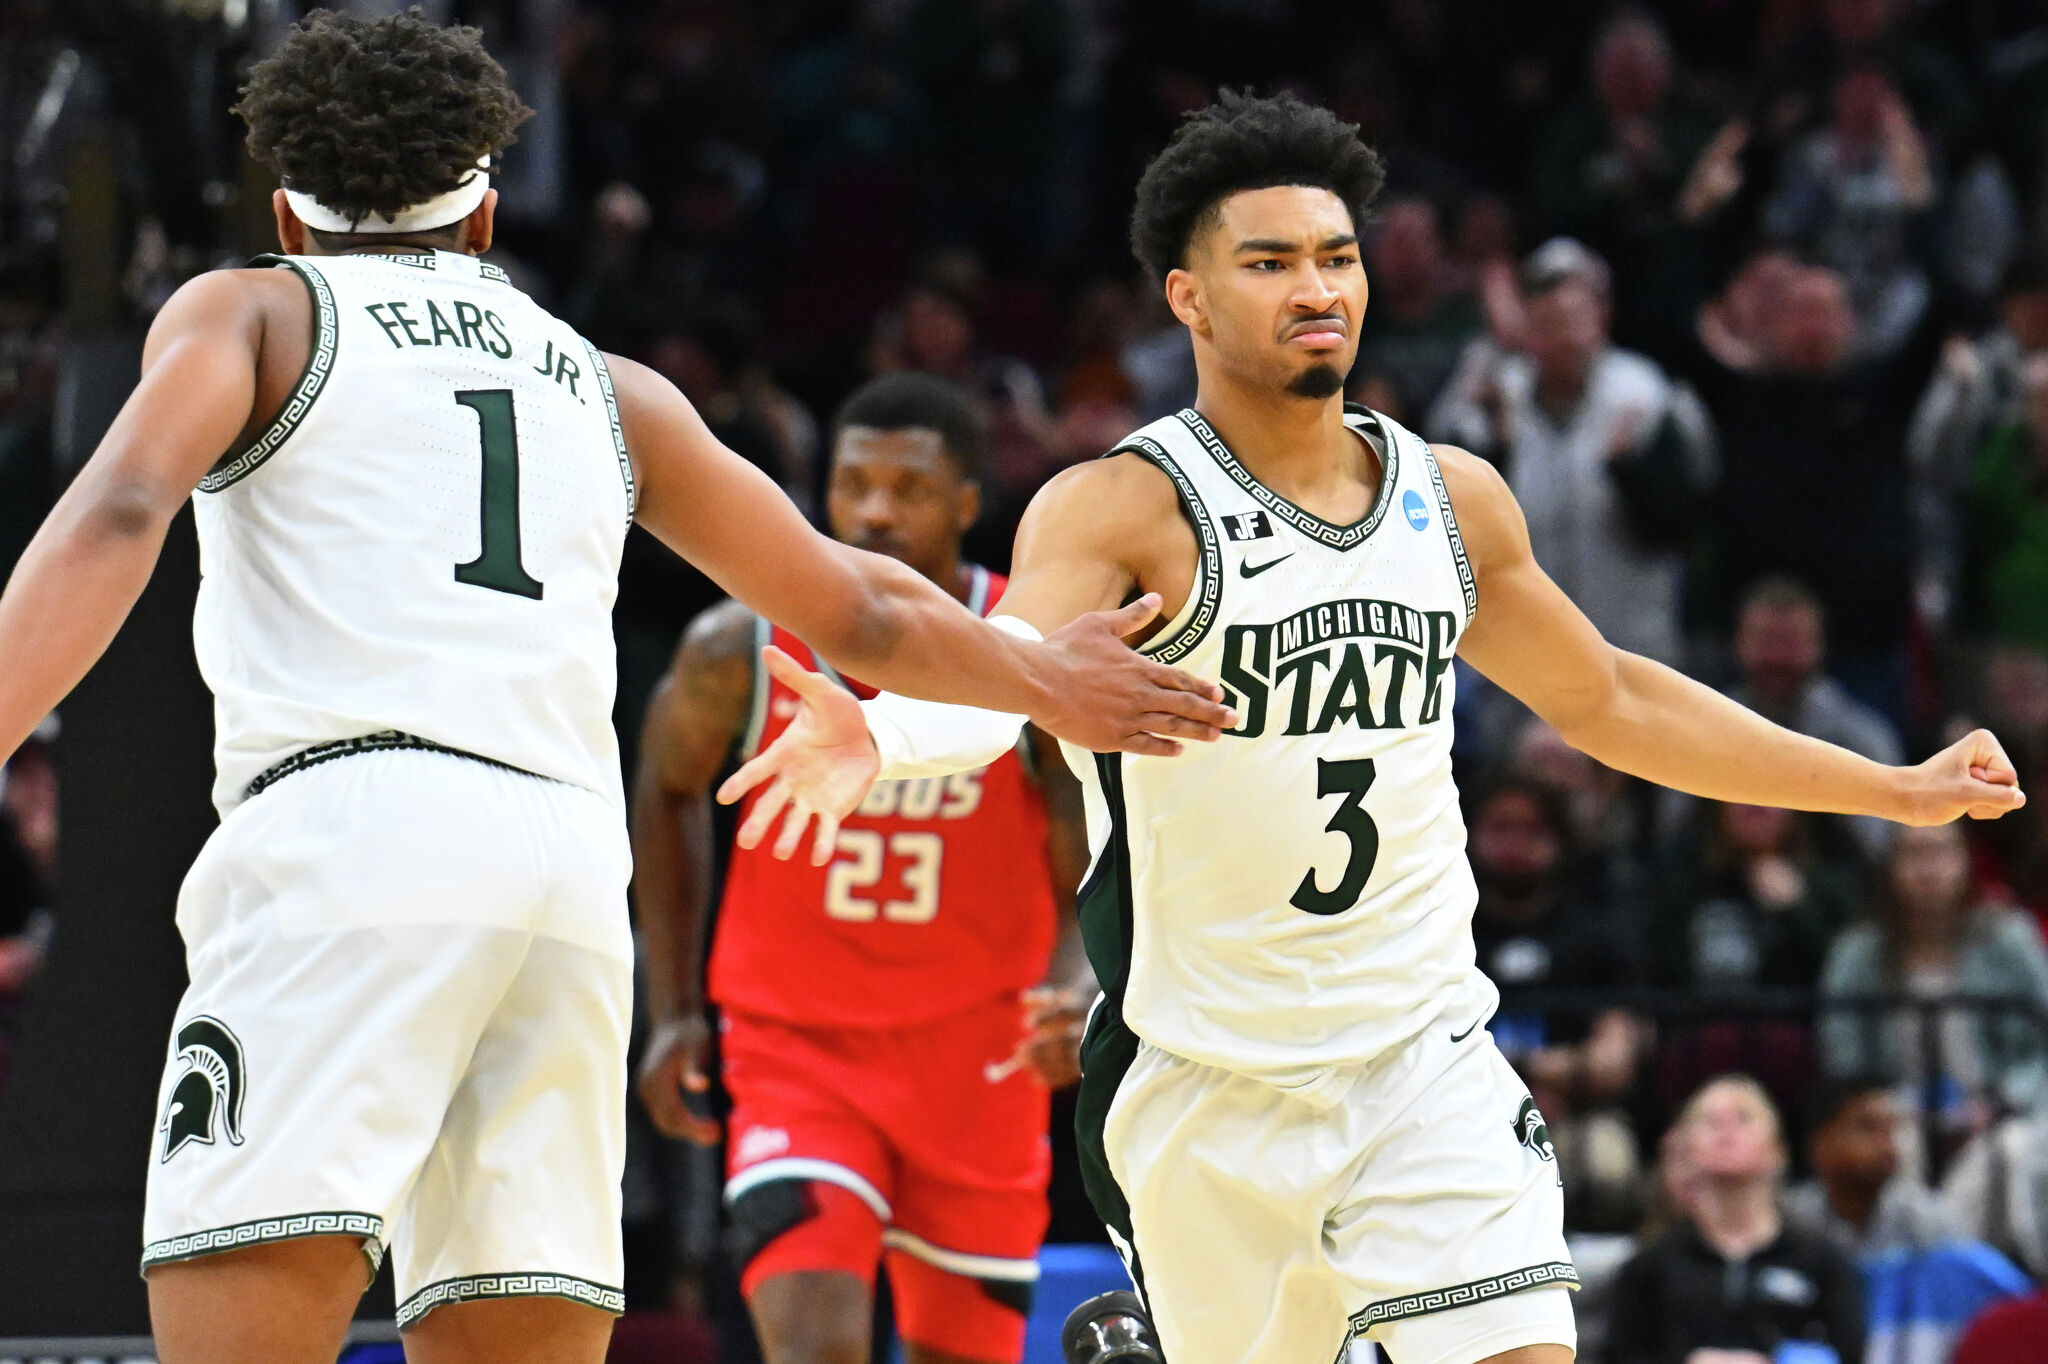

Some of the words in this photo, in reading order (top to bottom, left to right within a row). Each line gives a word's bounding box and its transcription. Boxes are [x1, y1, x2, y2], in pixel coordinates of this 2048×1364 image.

[365, 299, 513, 360] FEARS
[532, 340, 586, 405] JR.
[454, 388, 544, 601] 1
[1234, 511, 1259, 540] JF
[1219, 610, 1457, 739] STATE
[1281, 601, 1421, 653] MICHIGAN
[824, 828, 944, 924] 23
[1288, 757, 1379, 916] 3
